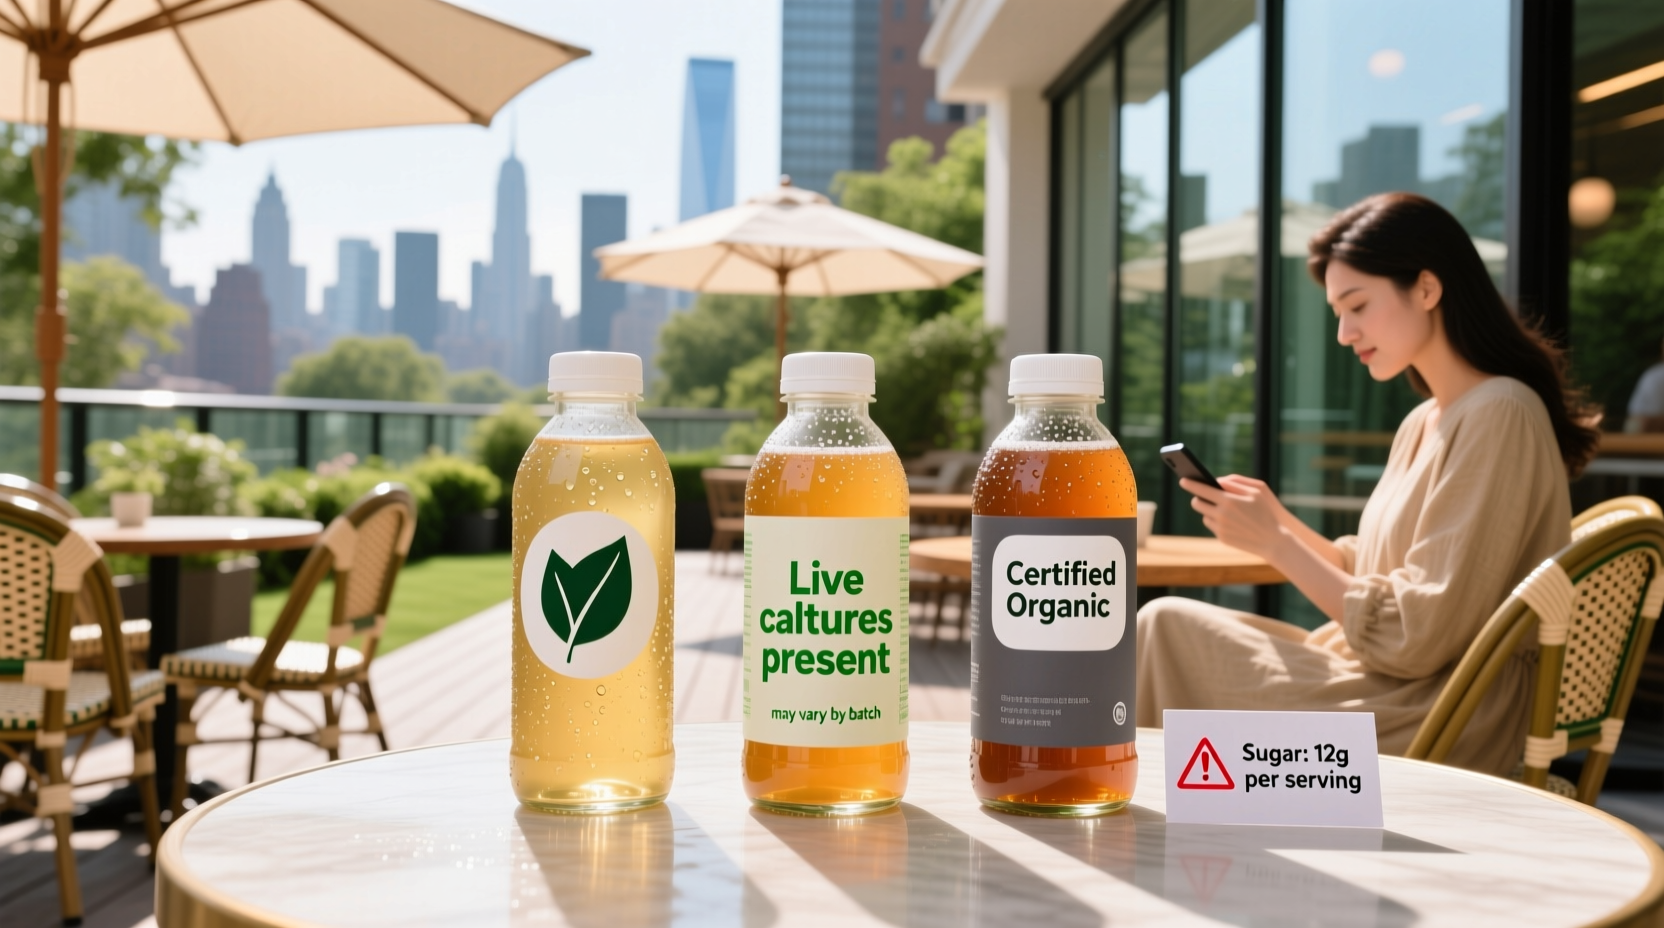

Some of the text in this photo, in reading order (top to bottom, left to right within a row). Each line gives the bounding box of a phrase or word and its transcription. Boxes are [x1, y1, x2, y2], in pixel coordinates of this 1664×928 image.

[790, 560, 864, 596] Live
[1006, 560, 1116, 586] Certified
[759, 601, 893, 635] caltures
[1006, 592, 1110, 625] Organic
[762, 642, 891, 683] present
[771, 706, 881, 725] may vary by batch
[1242, 742, 1349, 768] Sugar: 12g
[1245, 769, 1361, 794] per serving
